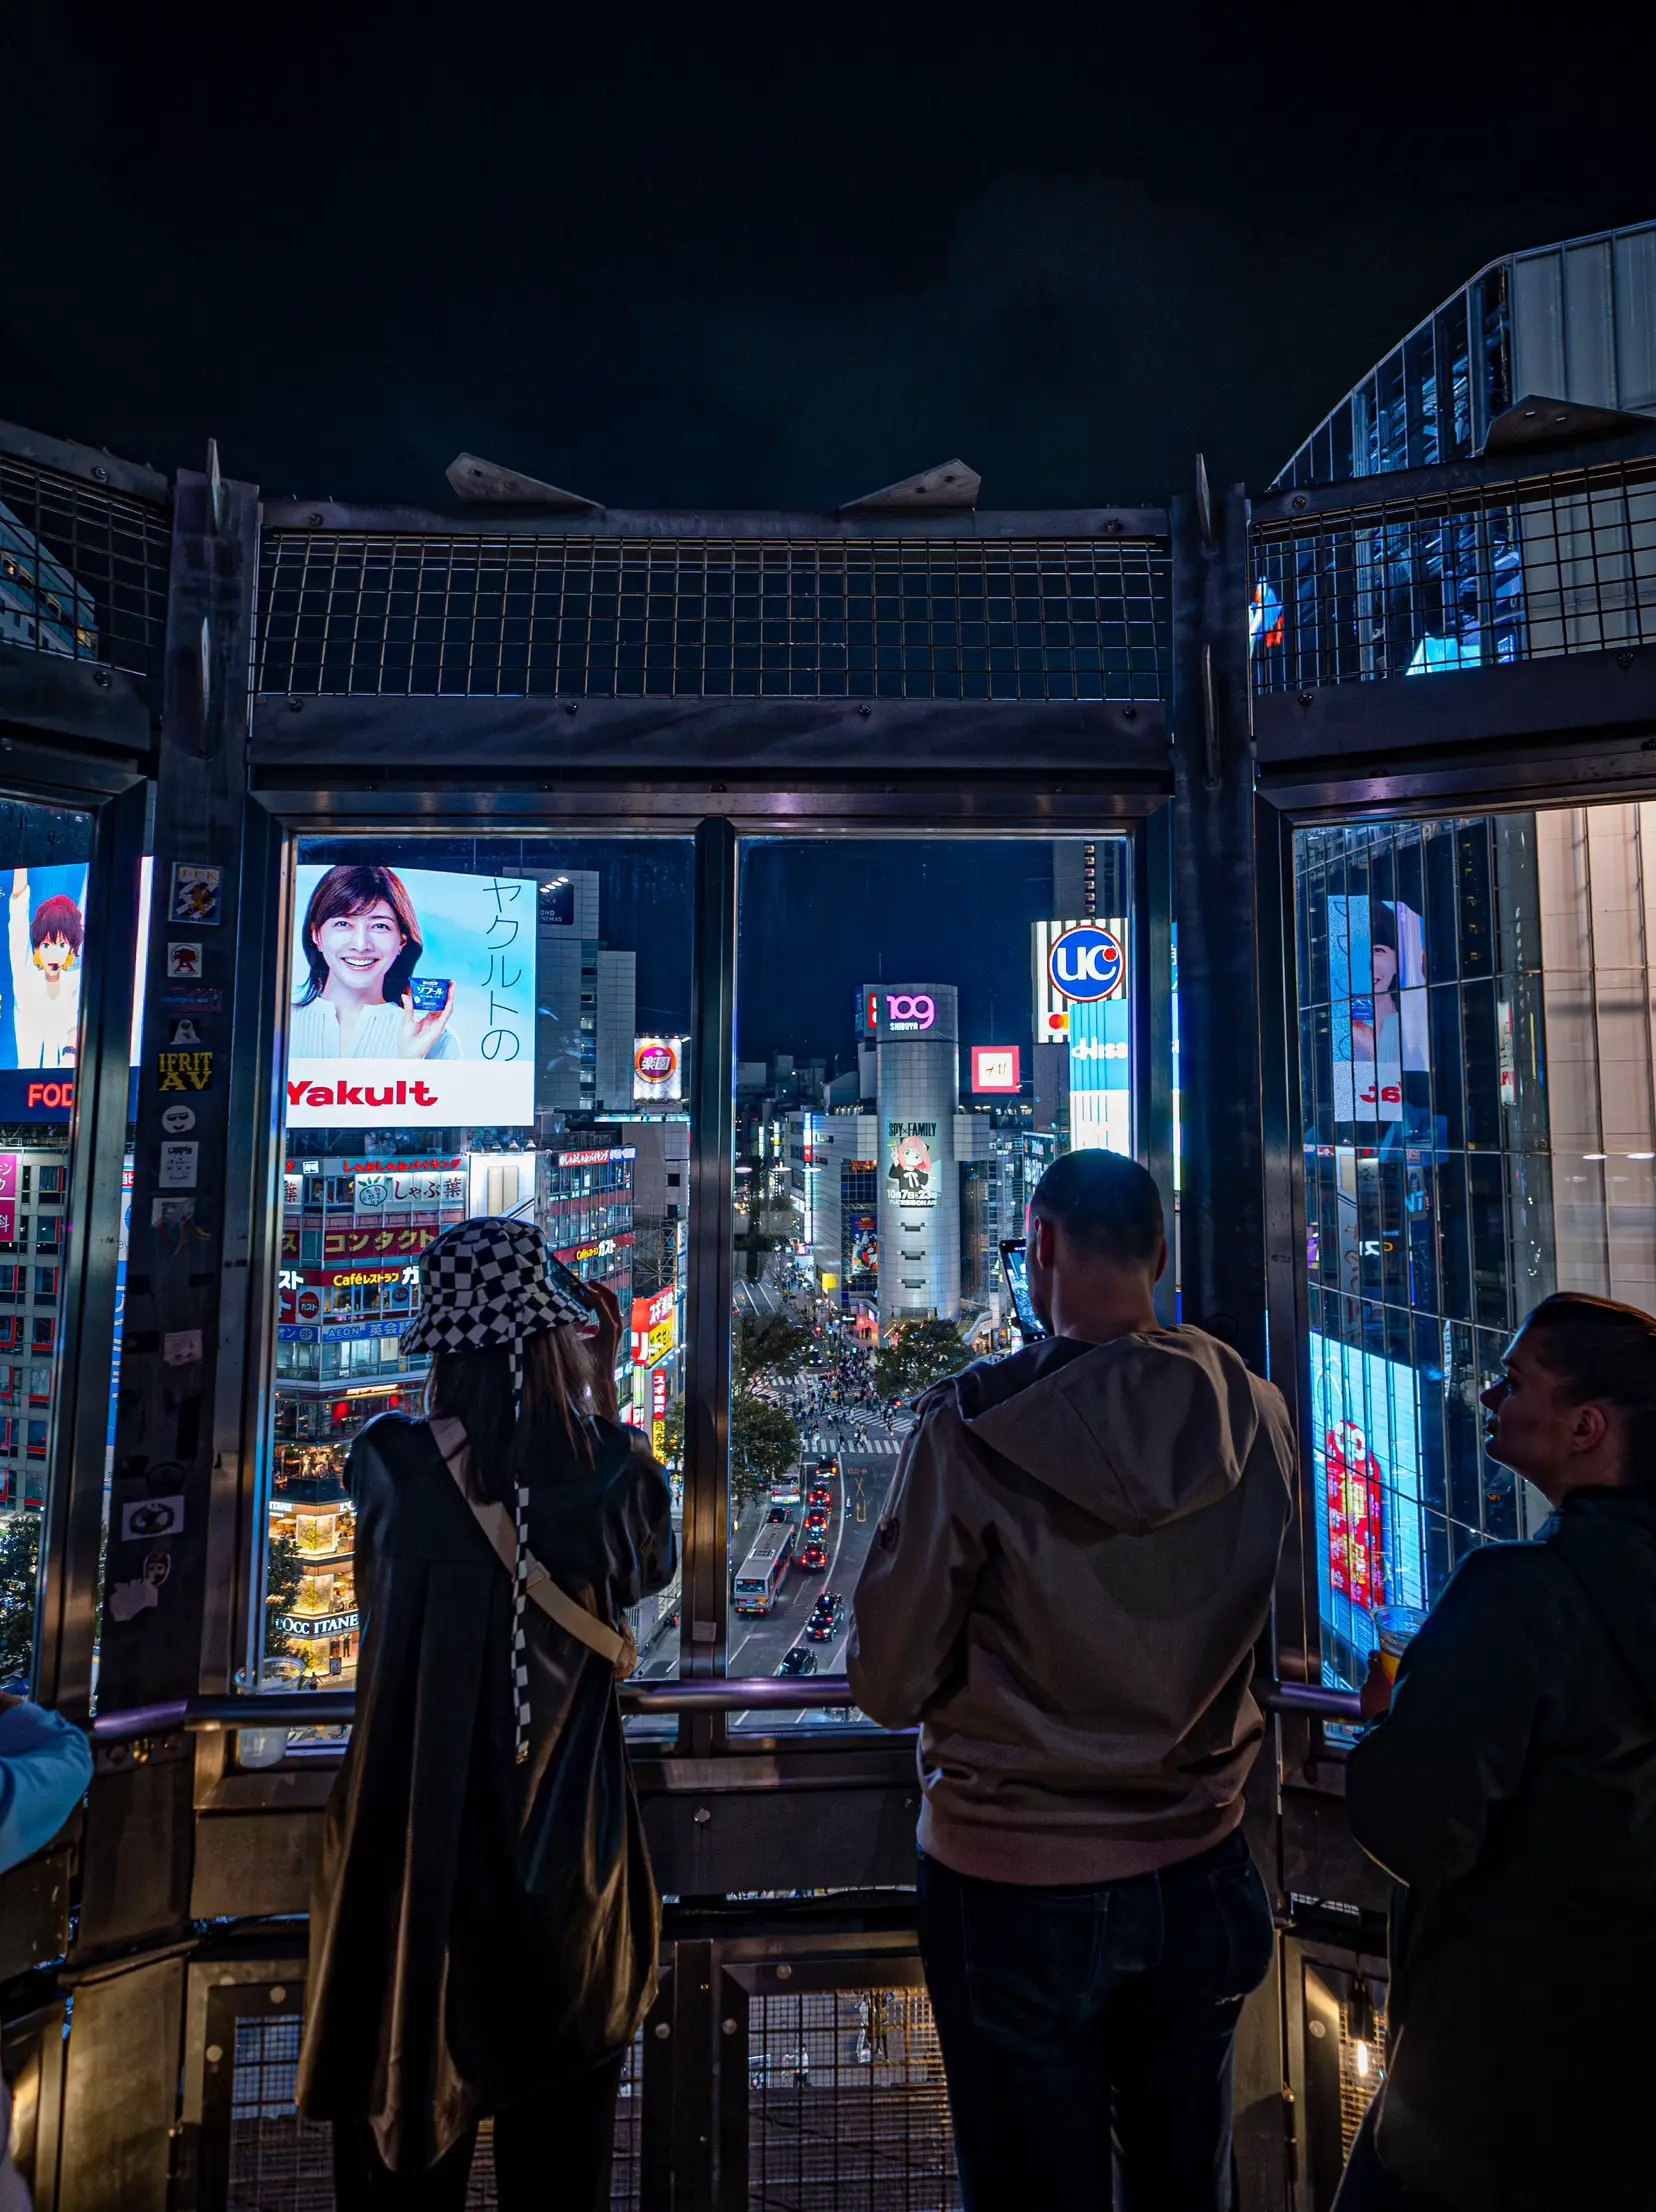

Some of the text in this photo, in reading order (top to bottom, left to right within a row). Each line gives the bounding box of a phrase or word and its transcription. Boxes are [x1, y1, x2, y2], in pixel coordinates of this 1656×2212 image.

[481, 878, 522, 1061] ヤクルトの
[886, 995, 935, 1030] 109
[889, 1022, 918, 1031] SHIBUYA
[159, 1053, 213, 1072] IFRIT
[287, 1081, 438, 1107] Yakult
[395, 1178, 462, 1200] しゃぶ葉
[325, 1229, 436, 1253] コンタクト
[328, 1326, 361, 1339] AEON
